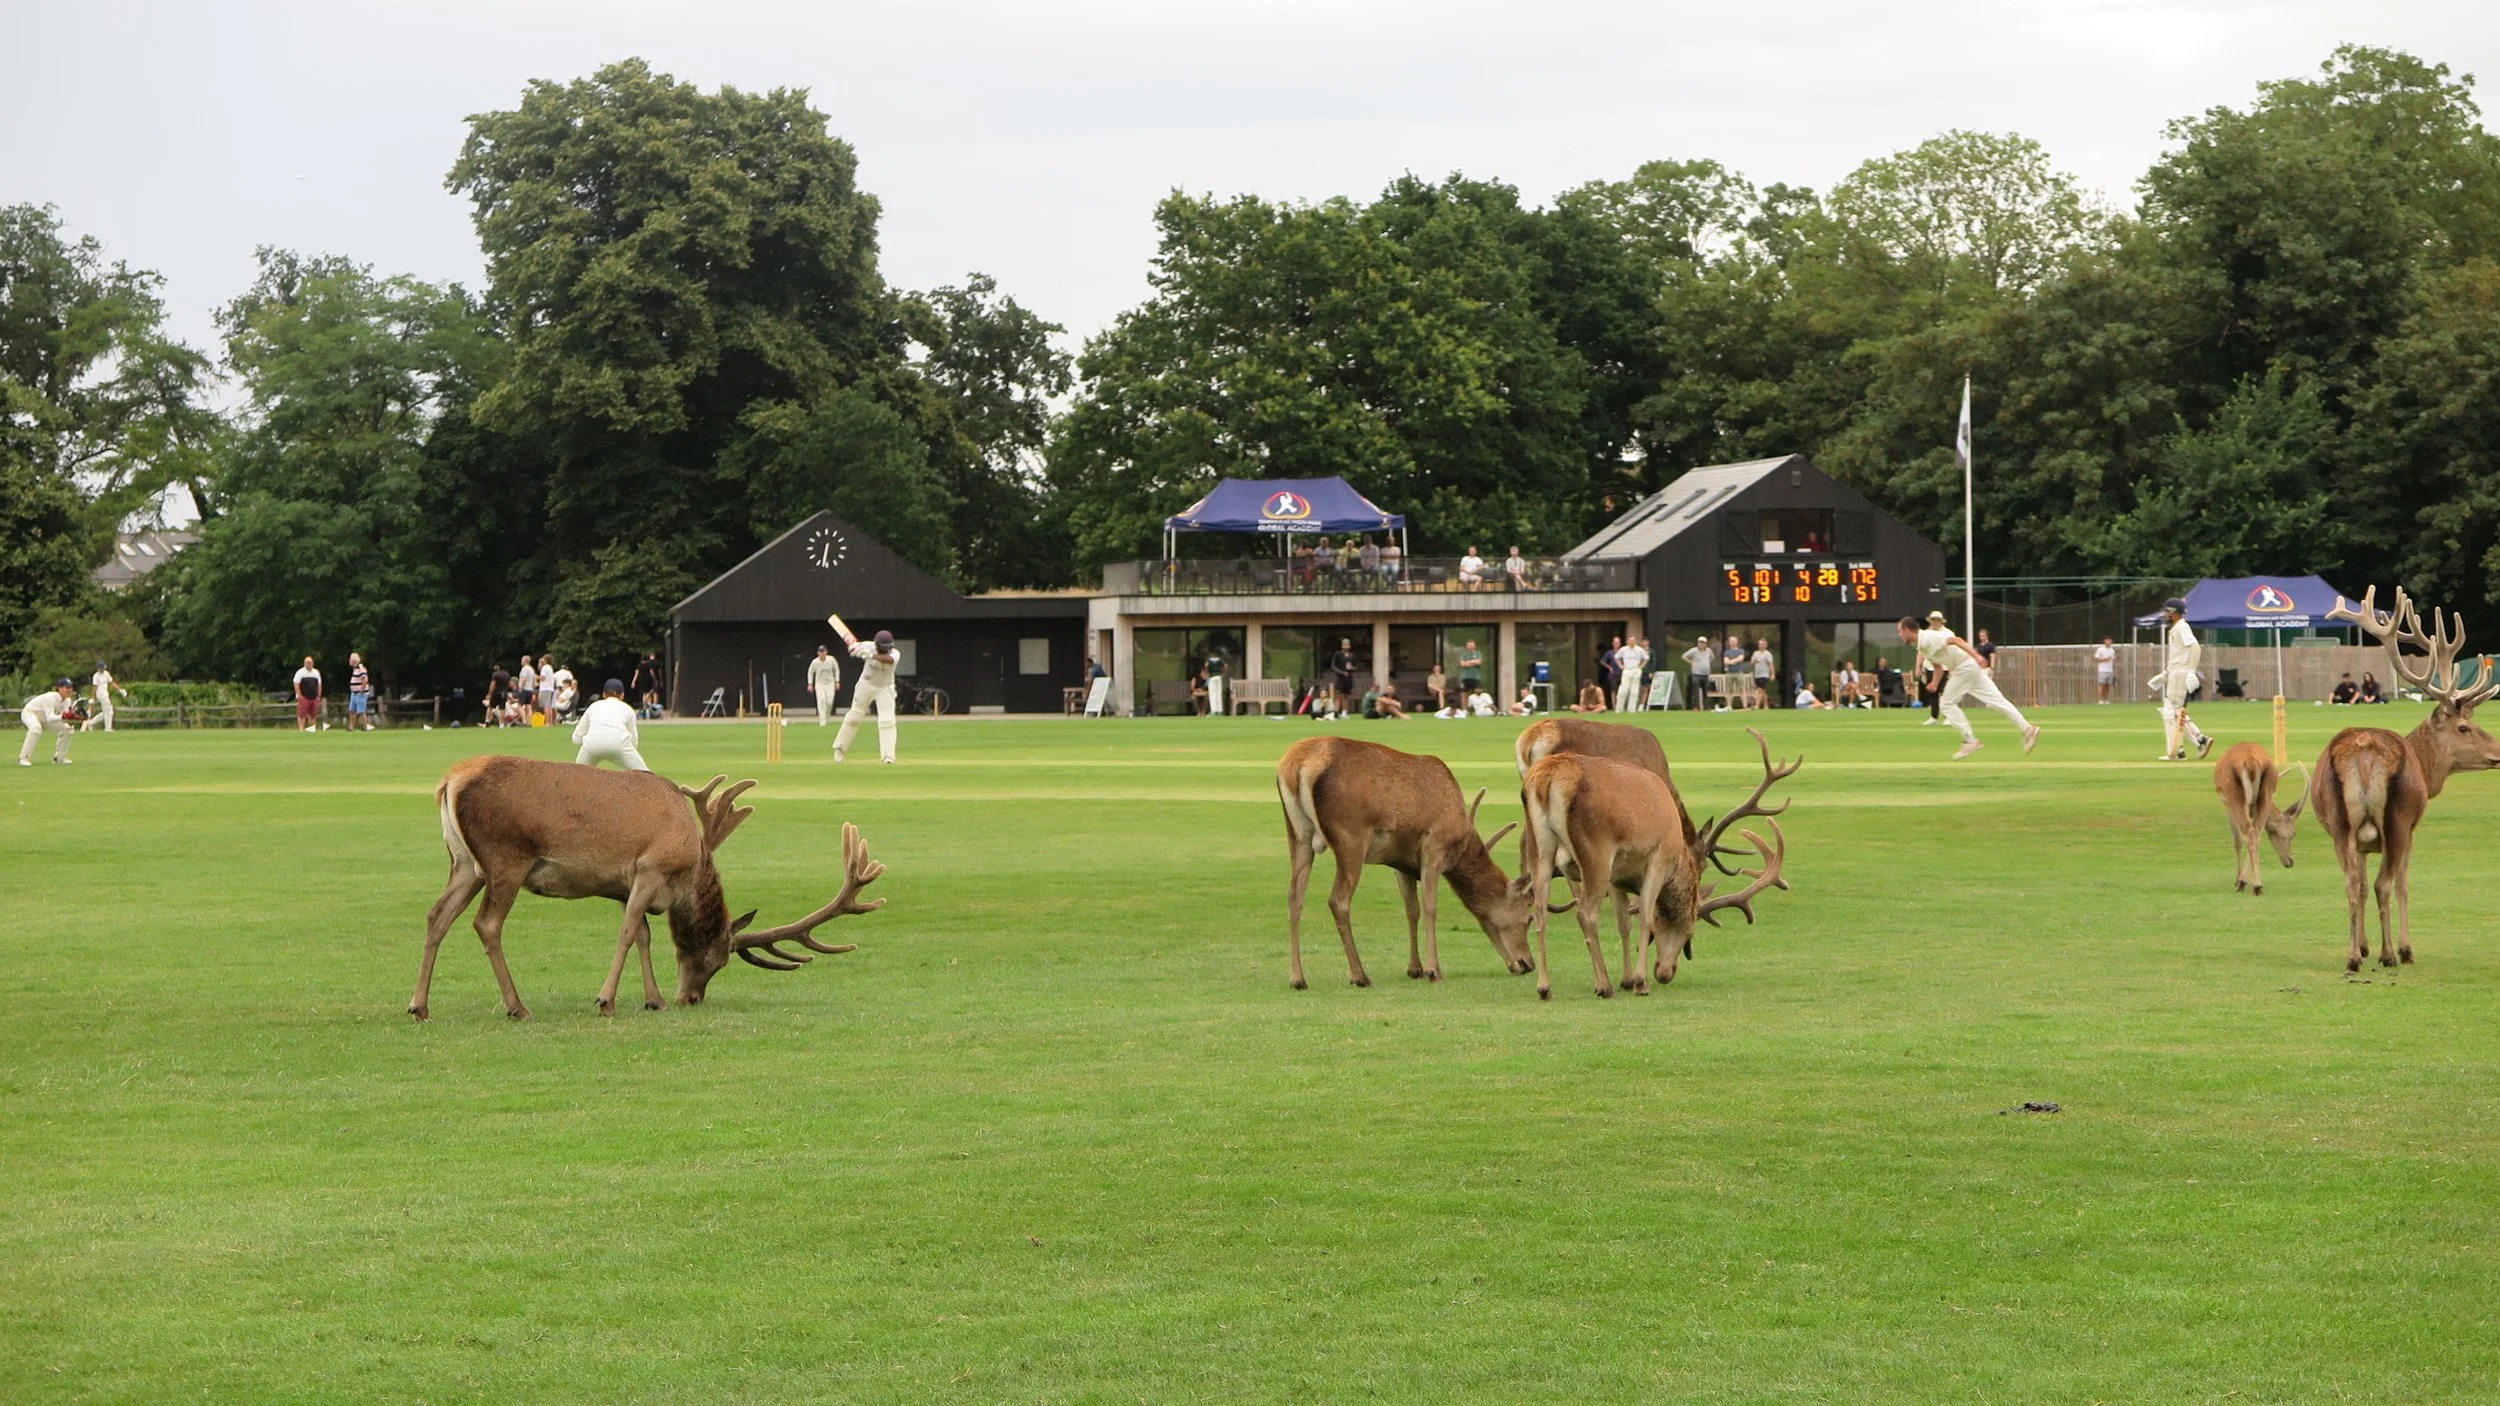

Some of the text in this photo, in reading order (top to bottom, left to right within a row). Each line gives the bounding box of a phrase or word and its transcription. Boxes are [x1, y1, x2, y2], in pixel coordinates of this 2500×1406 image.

[1729, 569, 1740, 586] 5
[1755, 569, 1780, 585] 101
[1799, 570, 1810, 584] 4
[1817, 568, 1839, 585] 28
[1852, 568, 1877, 584] 172
[1735, 586, 1751, 603] 13
[1760, 585, 1771, 603] 3
[1795, 585, 1810, 602] 10
[1856, 585, 1877, 601] 51
